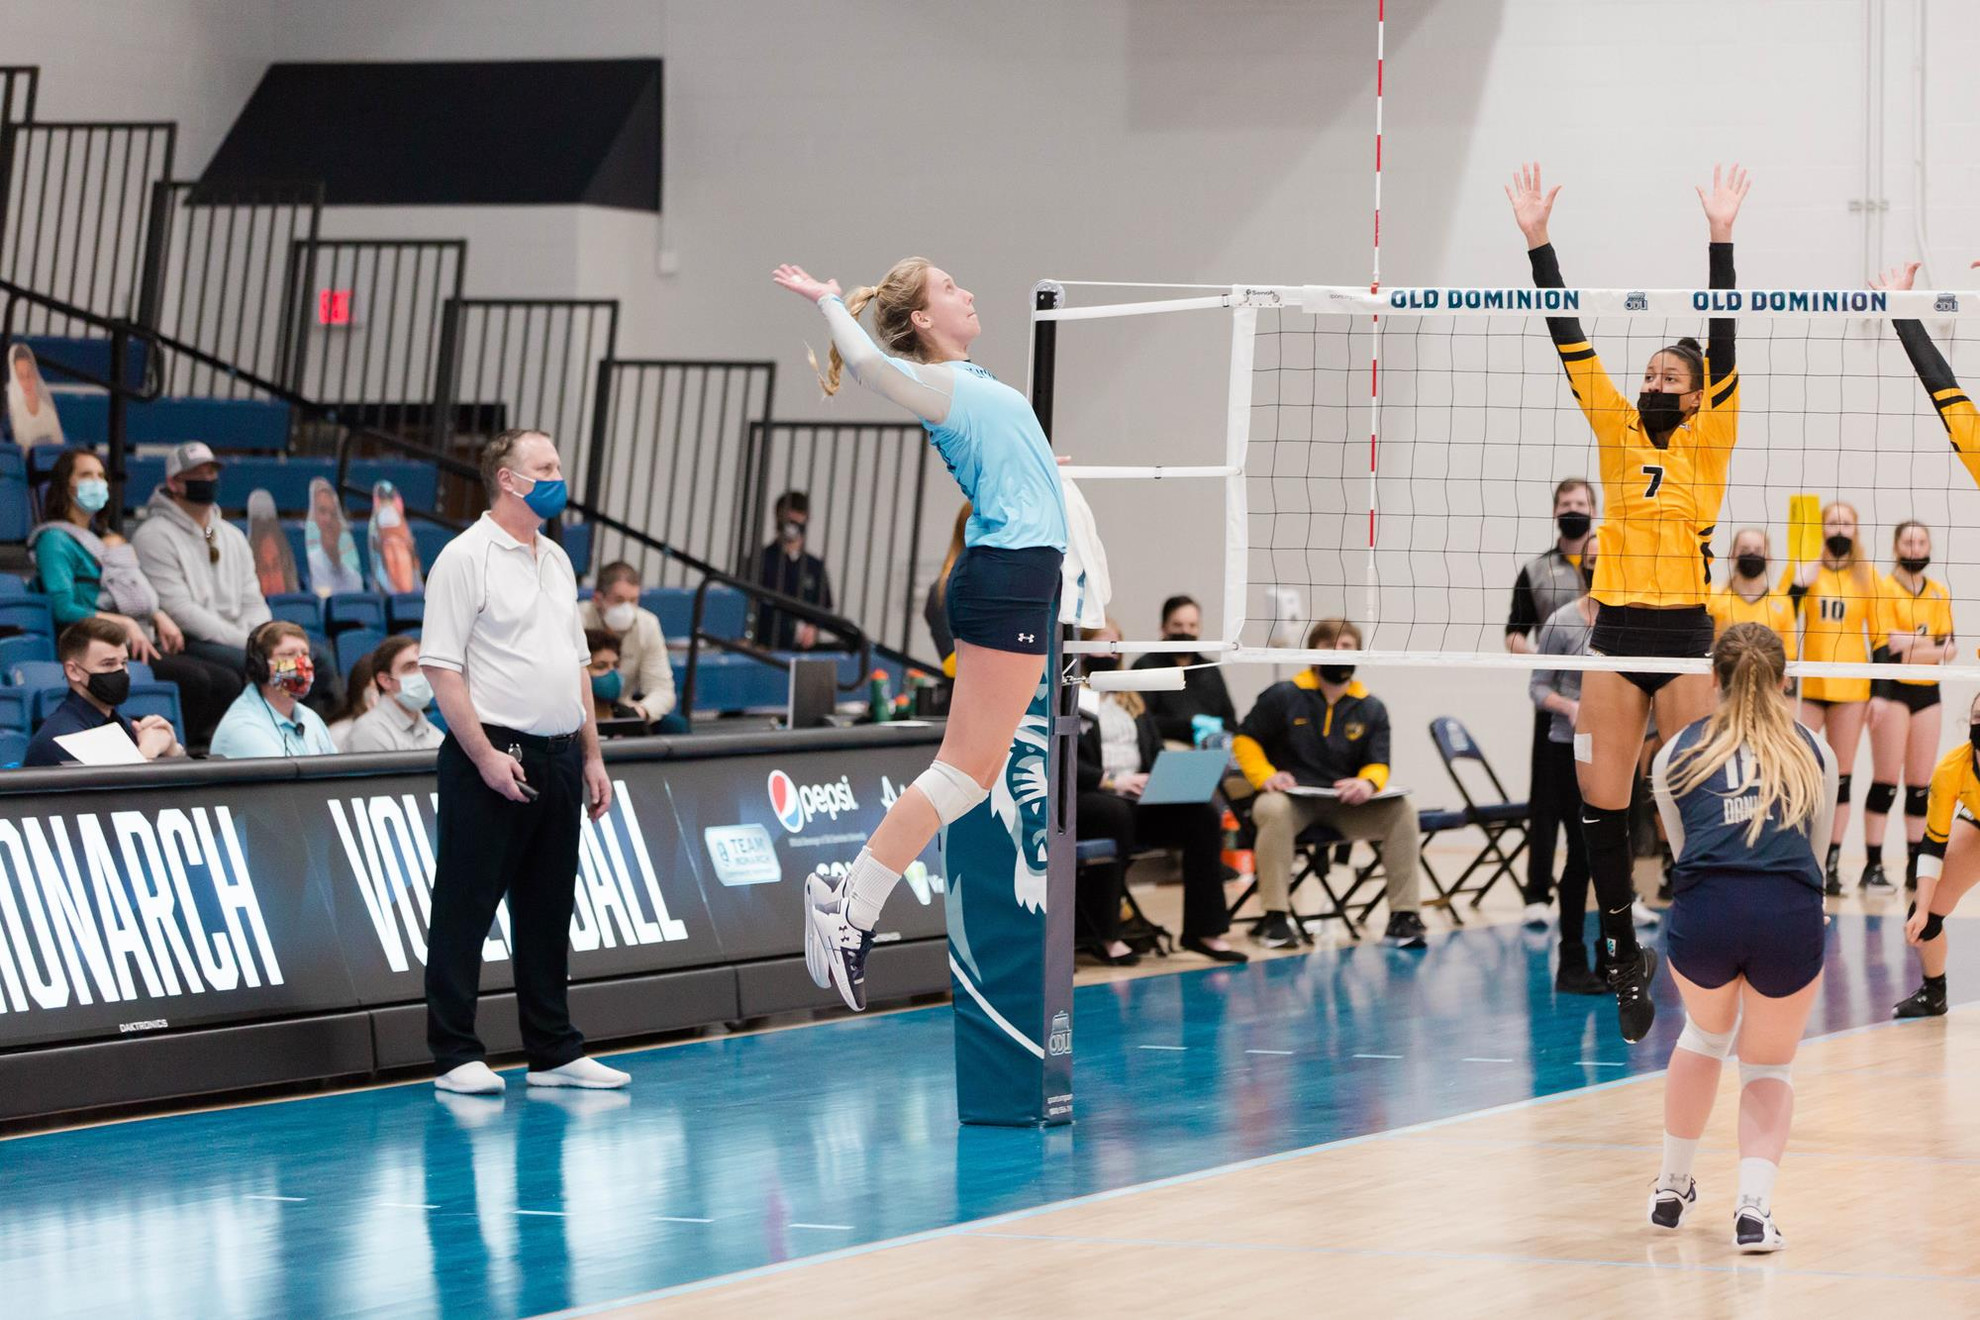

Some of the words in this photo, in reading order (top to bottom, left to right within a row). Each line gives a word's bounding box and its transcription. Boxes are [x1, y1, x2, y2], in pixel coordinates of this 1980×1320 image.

[1390, 289, 1439, 309] OLD
[1447, 289, 1579, 310] DOMINION
[1624, 299, 1648, 310] ODU
[1692, 291, 1742, 311] OLD
[1751, 291, 1887, 312] DOMINION
[1933, 300, 1958, 312] ODU
[1641, 465, 1664, 498] 7
[1820, 598, 1846, 621] 10
[799, 775, 859, 823] pepsi
[729, 836, 767, 853] TEAM
[0, 805, 285, 1014] ONARCH
[119, 1018, 168, 1033] DAKTRONICS
